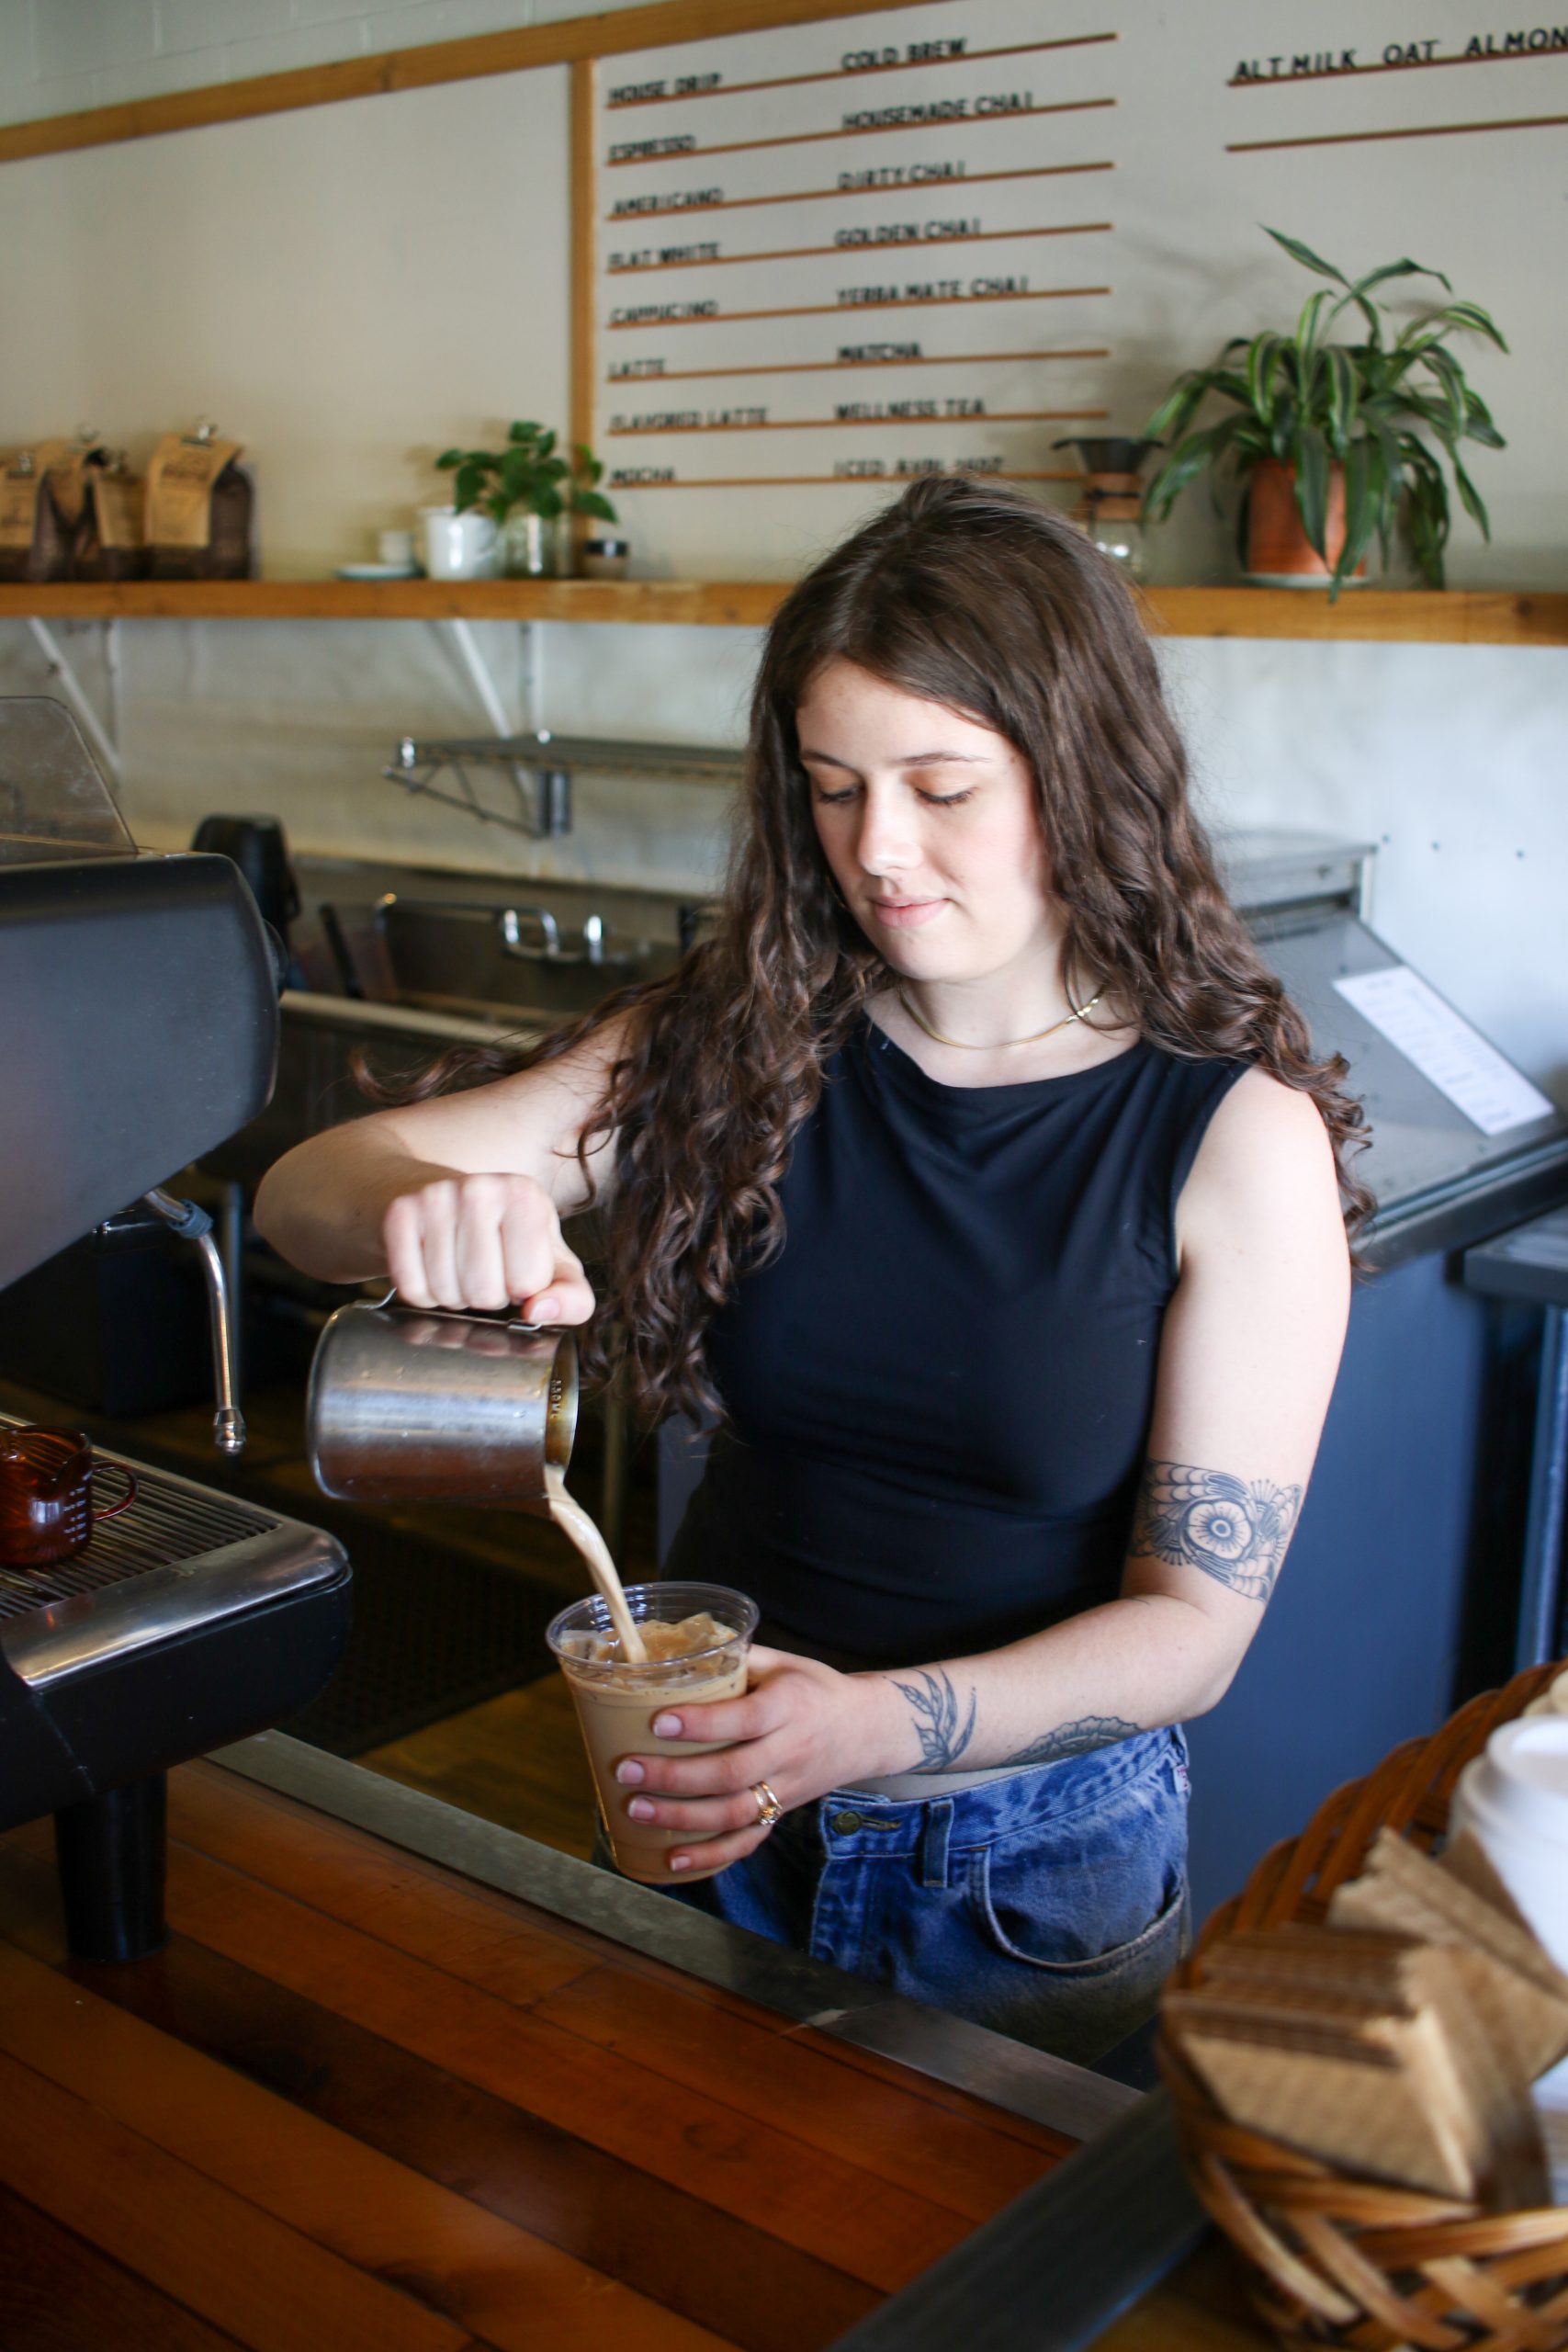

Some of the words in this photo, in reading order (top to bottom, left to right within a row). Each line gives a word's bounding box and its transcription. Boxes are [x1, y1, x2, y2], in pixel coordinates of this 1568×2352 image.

[841, 47, 898, 70] COLD
[907, 37, 967, 62] BREW
[1234, 56, 1283, 79] ALT
[1291, 48, 1357, 74] MILK
[1382, 39, 1439, 65] OAT
[609, 80, 666, 103] HOUSE
[675, 73, 722, 94] DRIP
[842, 97, 967, 129] HOUSEMADE
[975, 92, 1033, 114] CHAI
[609, 134, 696, 161] ESPRESSO
[838, 164, 904, 189] DIRTY
[909, 160, 965, 181] CHAI
[614, 187, 724, 214] AMERICANO
[834, 223, 919, 246] GOLDEN
[924, 217, 981, 238] CHAI
[609, 249, 652, 268] FLAT
[660, 241, 720, 265] WHITE
[837, 283, 898, 304] YERBA
[906, 279, 962, 300] MATE
[970, 275, 1029, 295] CHAI
[837, 342, 923, 363] MATCHA
[608, 356, 666, 379] LATTE
[706, 407, 767, 427] LATTE
[834, 401, 937, 420] WELLNESS
[944, 398, 986, 415] TEA
[612, 467, 675, 484] MOCHA
[834, 458, 885, 477] ICED
